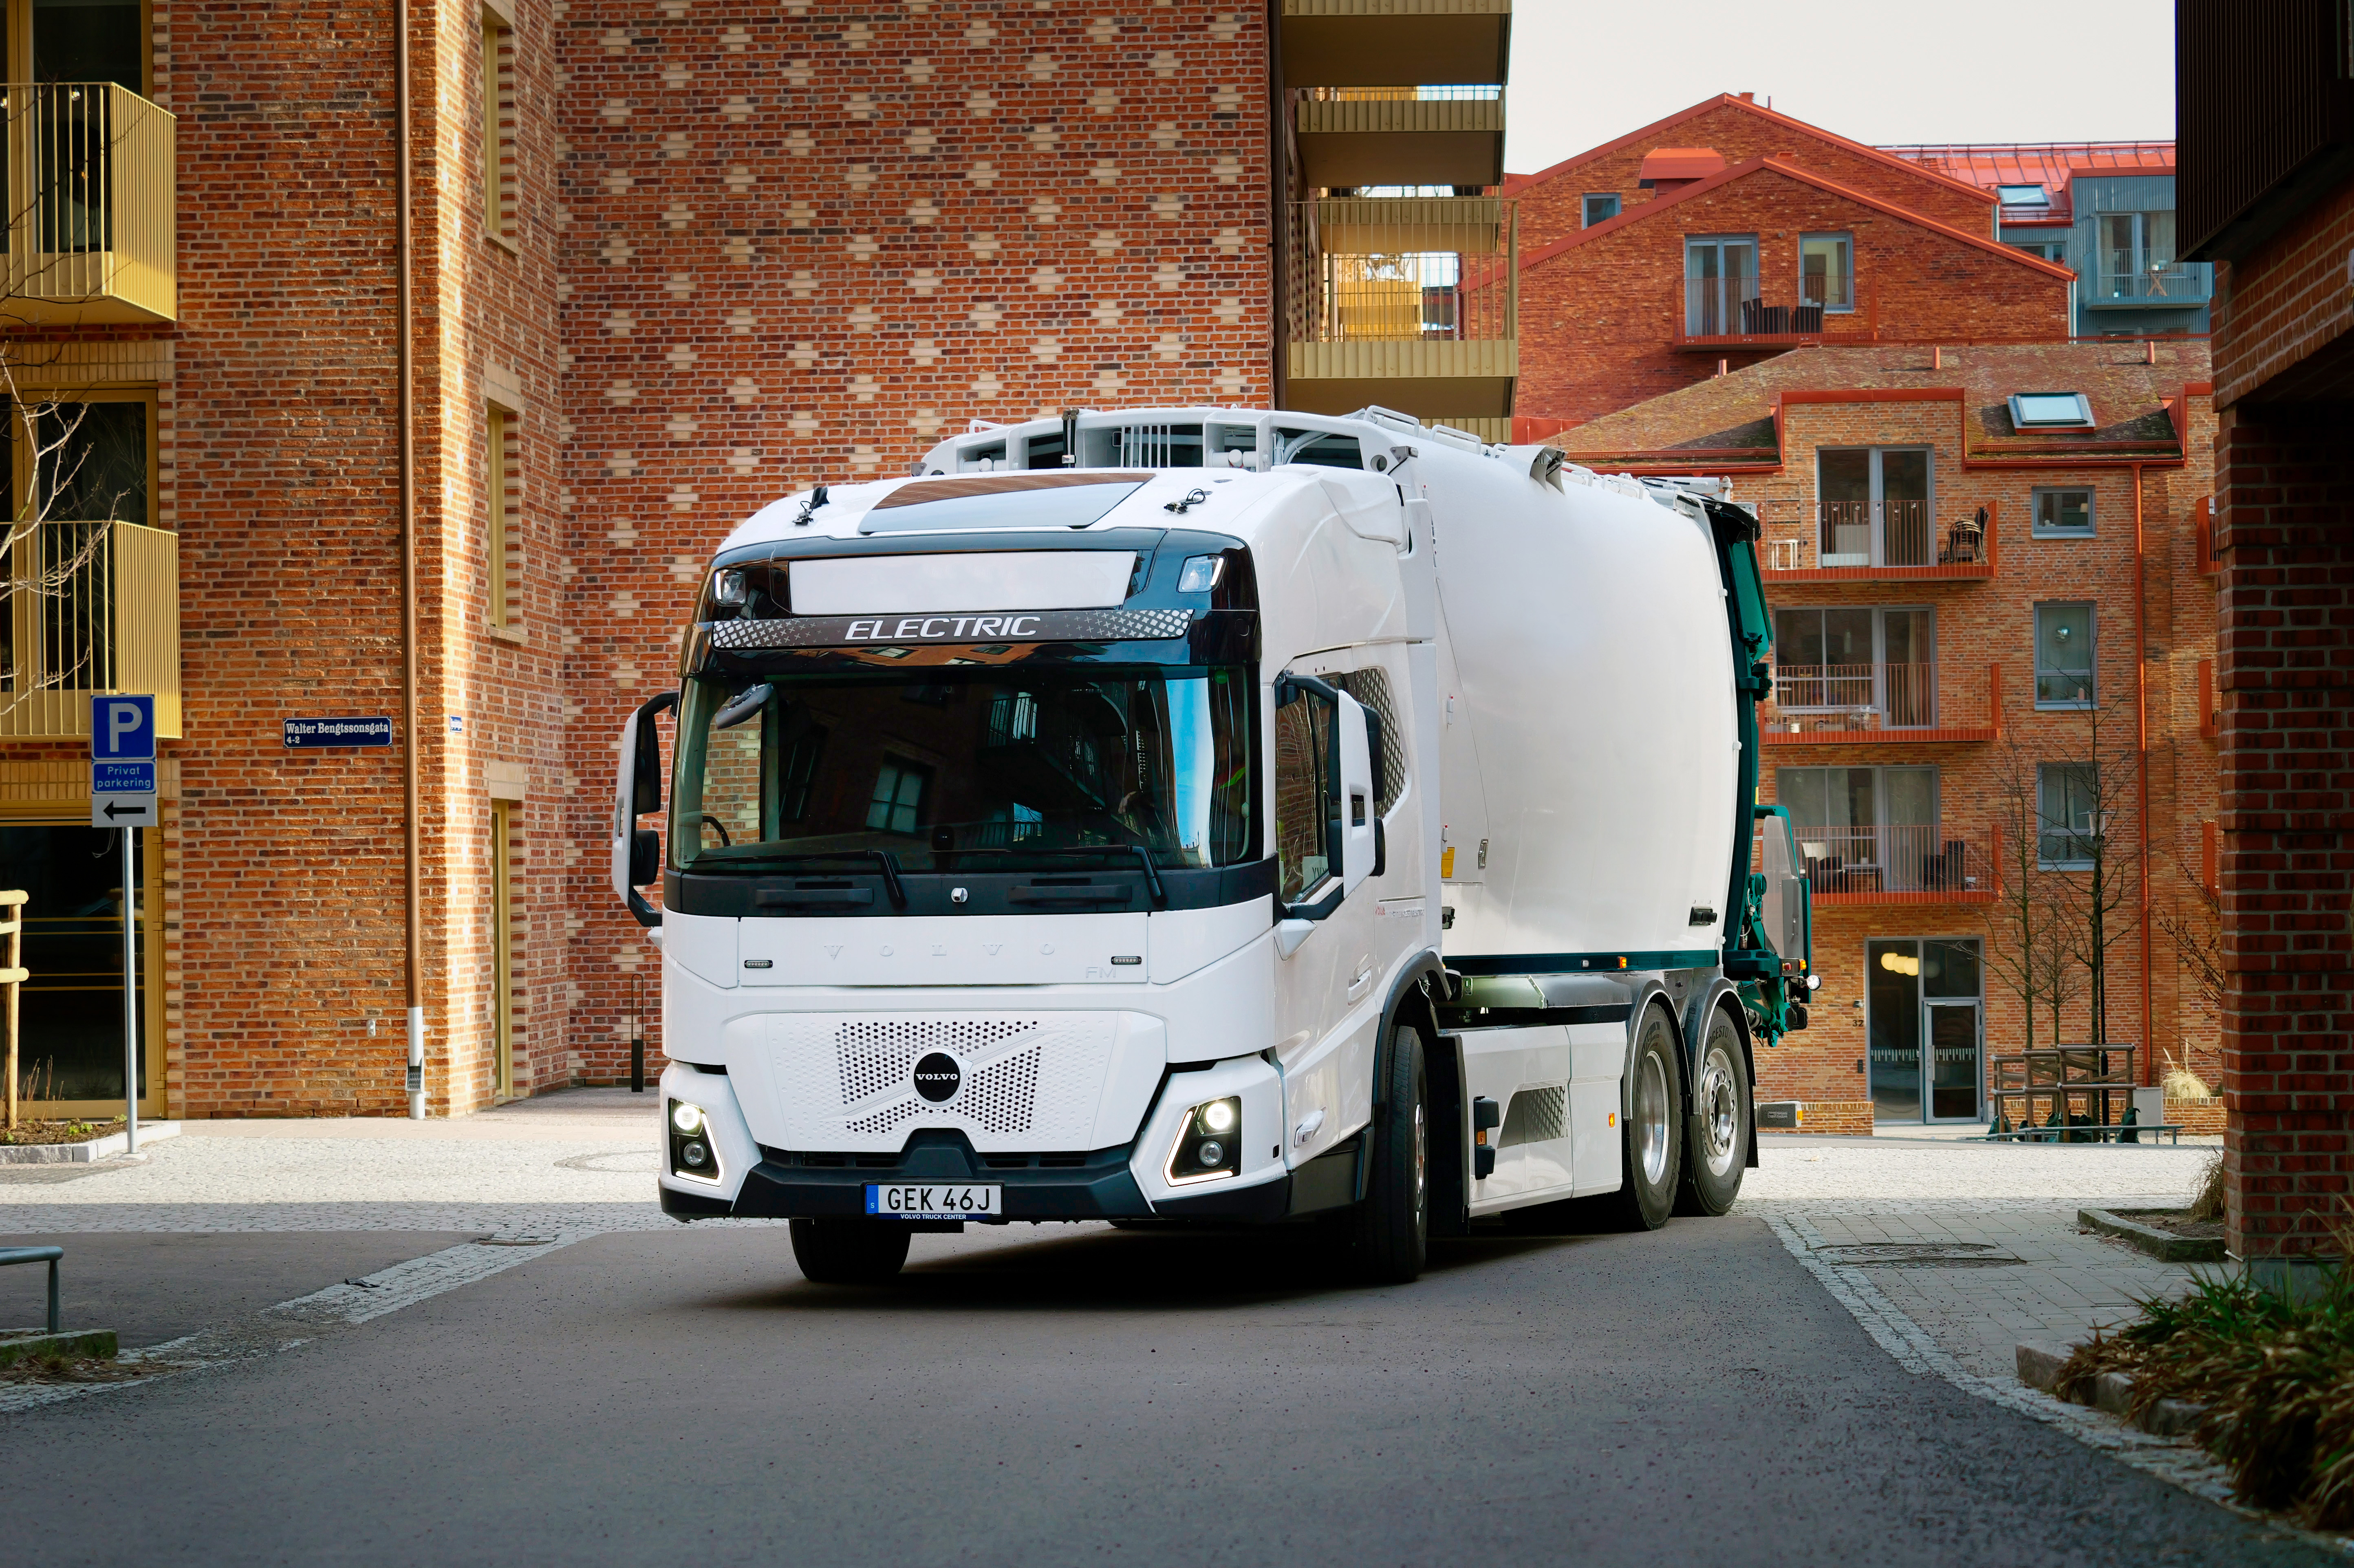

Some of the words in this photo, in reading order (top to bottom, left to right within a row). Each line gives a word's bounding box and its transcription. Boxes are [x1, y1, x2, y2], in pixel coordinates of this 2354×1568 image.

[845, 617, 1041, 640] ELECTRIC
[109, 703, 143, 752] P
[286, 723, 316, 734] Walter
[318, 722, 389, 736] Bengtssonsgata
[108, 766, 140, 775] Privat
[97, 777, 151, 789] parkering
[824, 943, 1055, 959] VOLVO
[1085, 966, 1116, 978] FM
[1704, 1025, 1736, 1061] IDGESTONE
[888, 1188, 933, 1211] GEK
[943, 1188, 990, 1211] 46J
